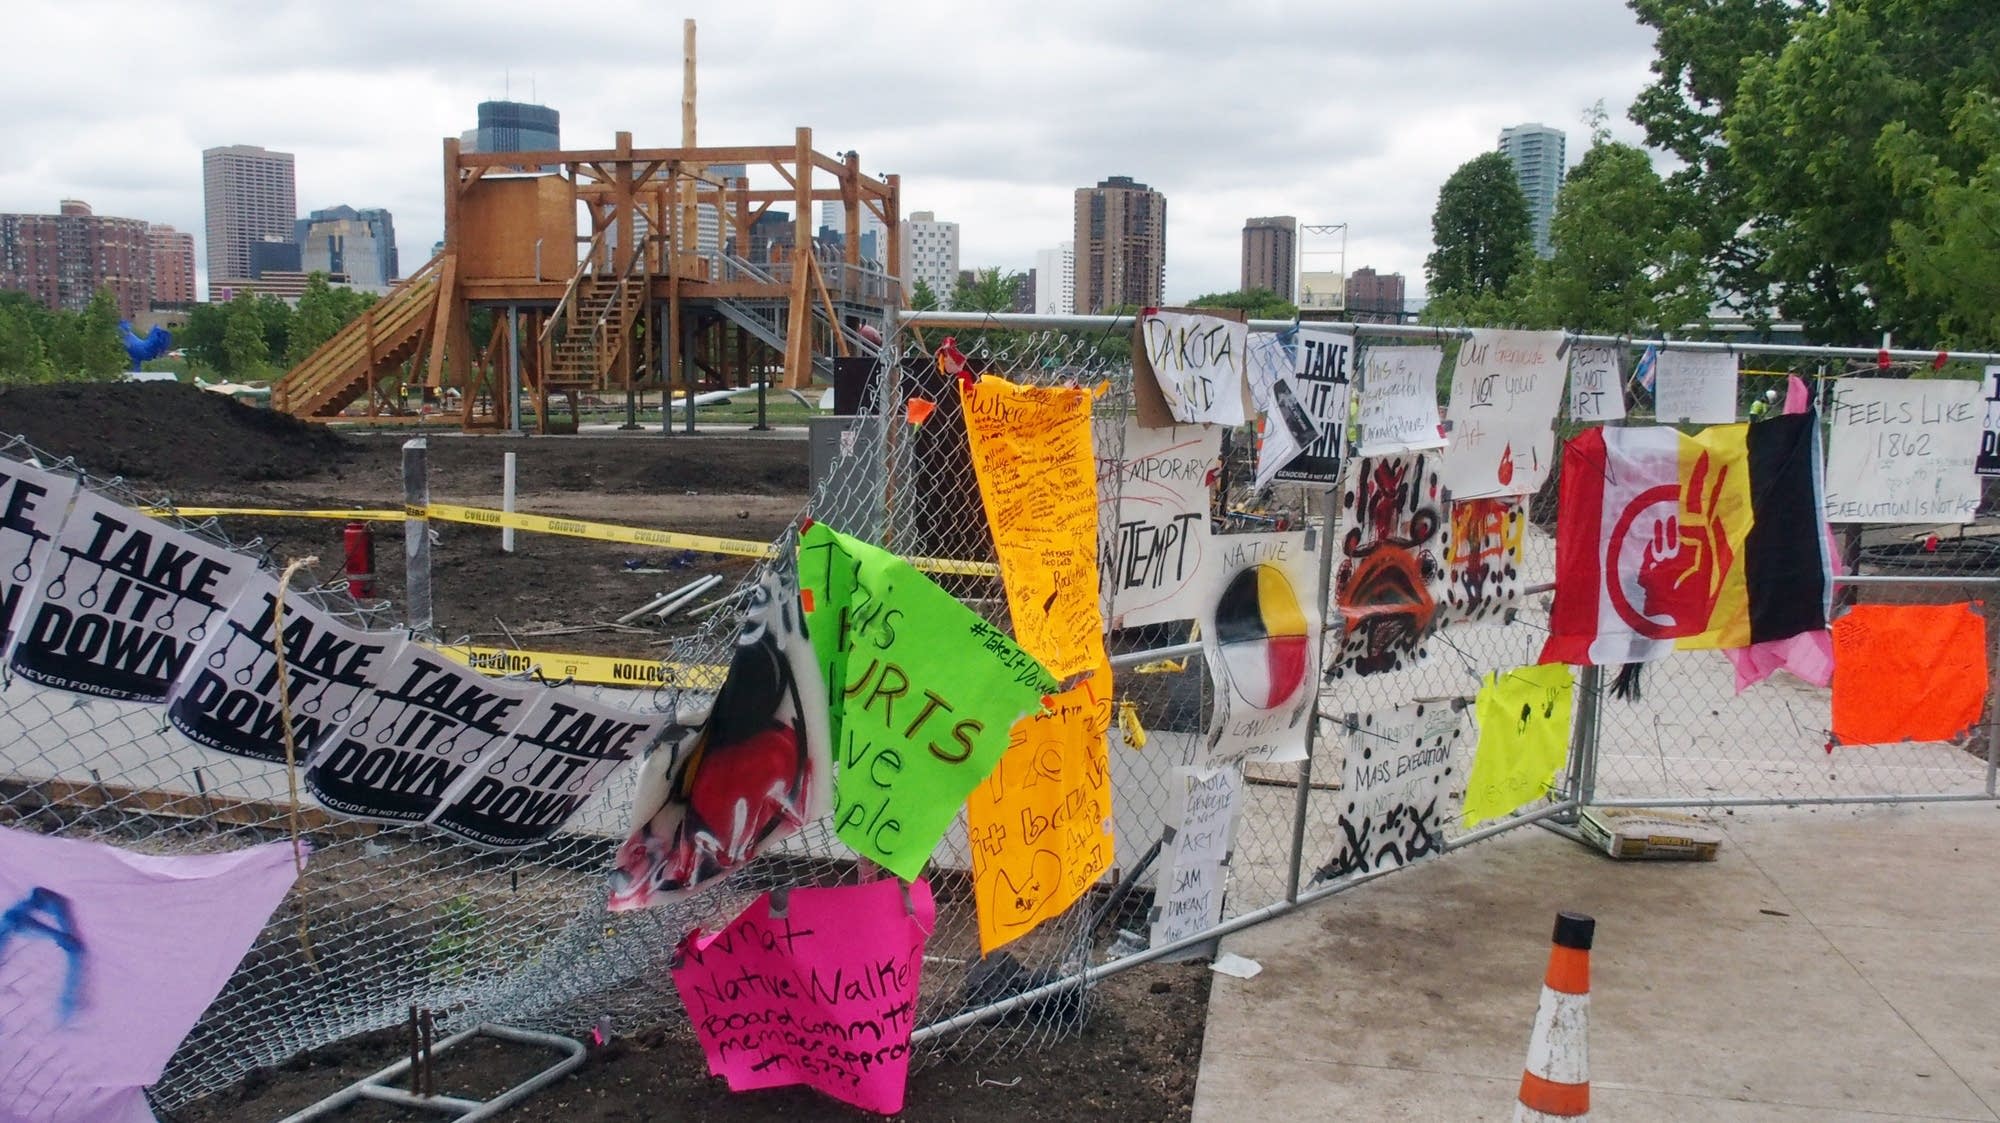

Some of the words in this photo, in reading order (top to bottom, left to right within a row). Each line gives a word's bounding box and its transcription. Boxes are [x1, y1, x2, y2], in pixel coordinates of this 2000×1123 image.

[1147, 319, 1235, 373] DAKOTA
[1302, 340, 1349, 383] TAKE
[1460, 337, 1489, 367] Our
[1311, 383, 1331, 418] IT
[1471, 374, 1500, 405] NOT
[1505, 374, 1538, 412] your
[1833, 389, 1912, 426] FEELS
[1921, 393, 1975, 425] LIKE
[1877, 432, 1931, 457] 1862
[1099, 456, 1212, 488] TEMPORARY
[1277, 470, 1308, 479] GENOCIDE
[1824, 493, 1910, 518] EXECUTION
[1914, 499, 1929, 516] IS
[85, 511, 232, 604] TAKE
[1097, 513, 1202, 596] NTEMPT
[1222, 540, 1289, 573] NATIVE
[103, 576, 168, 622] IT
[27, 602, 198, 682] DOWN
[248, 592, 385, 683] TAKE
[16, 663, 66, 687] NEVER
[69, 679, 130, 698] FORGET
[254, 661, 320, 708] IT
[613, 662, 676, 683] CAUTION
[183, 667, 341, 750] DOWN
[394, 658, 523, 731] TAKE
[172, 715, 220, 748] SHAME
[244, 749, 304, 767] WALKR
[395, 709, 458, 750] IT
[534, 702, 650, 759] TAKE
[320, 738, 467, 799] DOWN
[529, 754, 590, 790] IT
[1355, 760, 1391, 792] MASS
[1396, 744, 1452, 778] EXECUTION
[306, 780, 366, 814] GENOCIDE
[399, 811, 426, 820] ART
[455, 775, 592, 825] DOWN
[440, 818, 480, 841] NEVER
[482, 832, 526, 846] FORGET
[1174, 868, 1201, 894] SAM
[695, 964, 798, 1014] Native
[701, 1007, 797, 1038] Board
